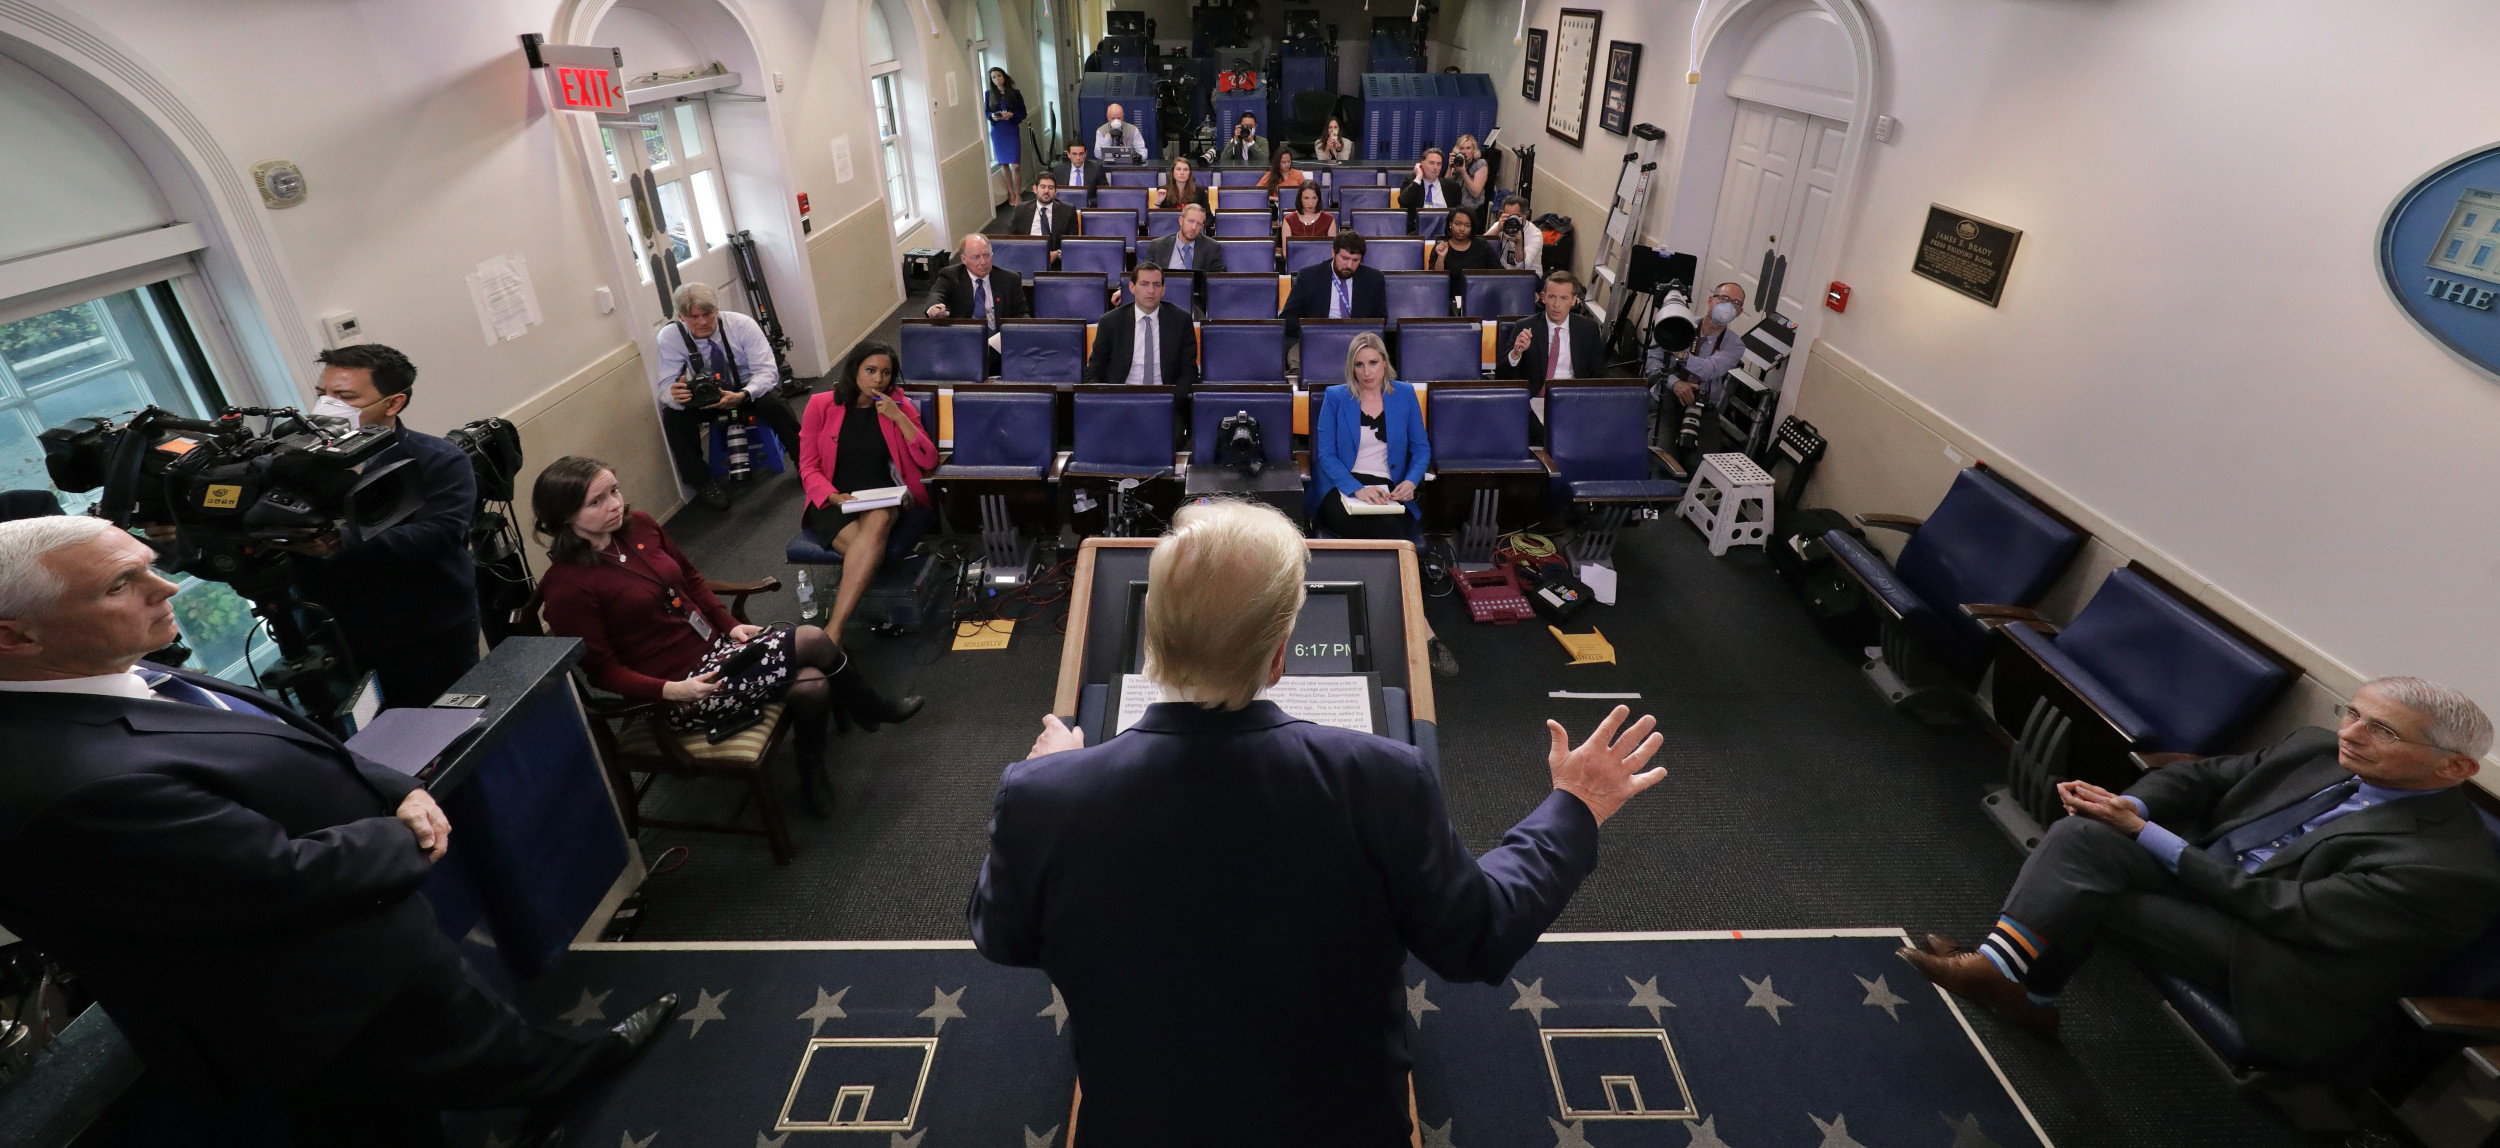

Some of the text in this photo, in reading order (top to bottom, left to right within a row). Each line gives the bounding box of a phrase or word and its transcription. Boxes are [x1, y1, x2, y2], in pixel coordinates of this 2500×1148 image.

[558, 67, 612, 108] EXIT
[1930, 238, 1994, 267] PRESS BRIEFING ROOM
[1935, 231, 1993, 257] JAMES S. BRADY
[2424, 276, 2495, 311] THE
[1295, 643, 1328, 657] 6:17
